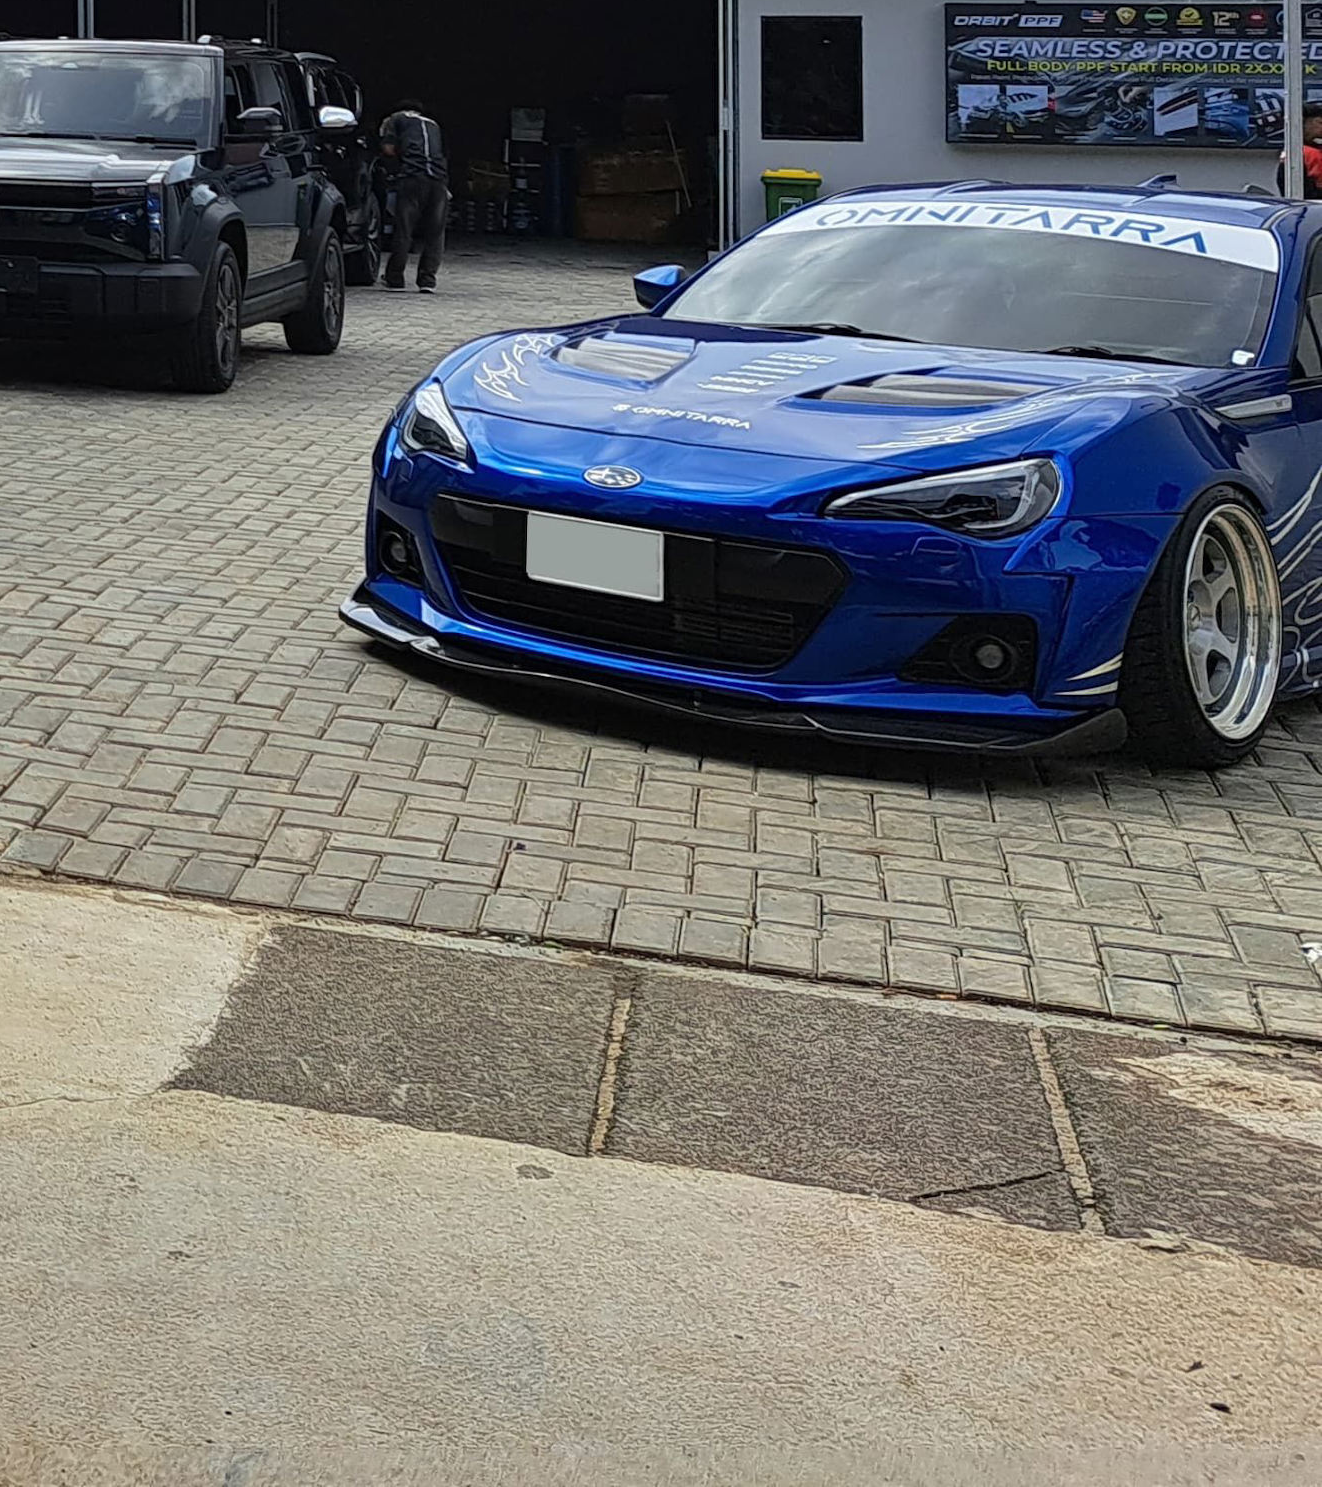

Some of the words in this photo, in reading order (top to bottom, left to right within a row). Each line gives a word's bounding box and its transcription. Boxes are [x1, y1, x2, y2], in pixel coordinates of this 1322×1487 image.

[1023, 16, 1061, 26] PPF
[977, 40, 1122, 58] SEAMLESS
[1129, 41, 1147, 58] &
[987, 60, 1024, 71] FULL
[1028, 61, 1072, 71] BODY
[1076, 61, 1106, 72] PPF
[1110, 62, 1157, 73] START
[1162, 63, 1207, 73] FROM
[1213, 63, 1241, 73] IDR
[817, 204, 1208, 254] OMNITARRA
[630, 405, 751, 430] OMNITARRA
